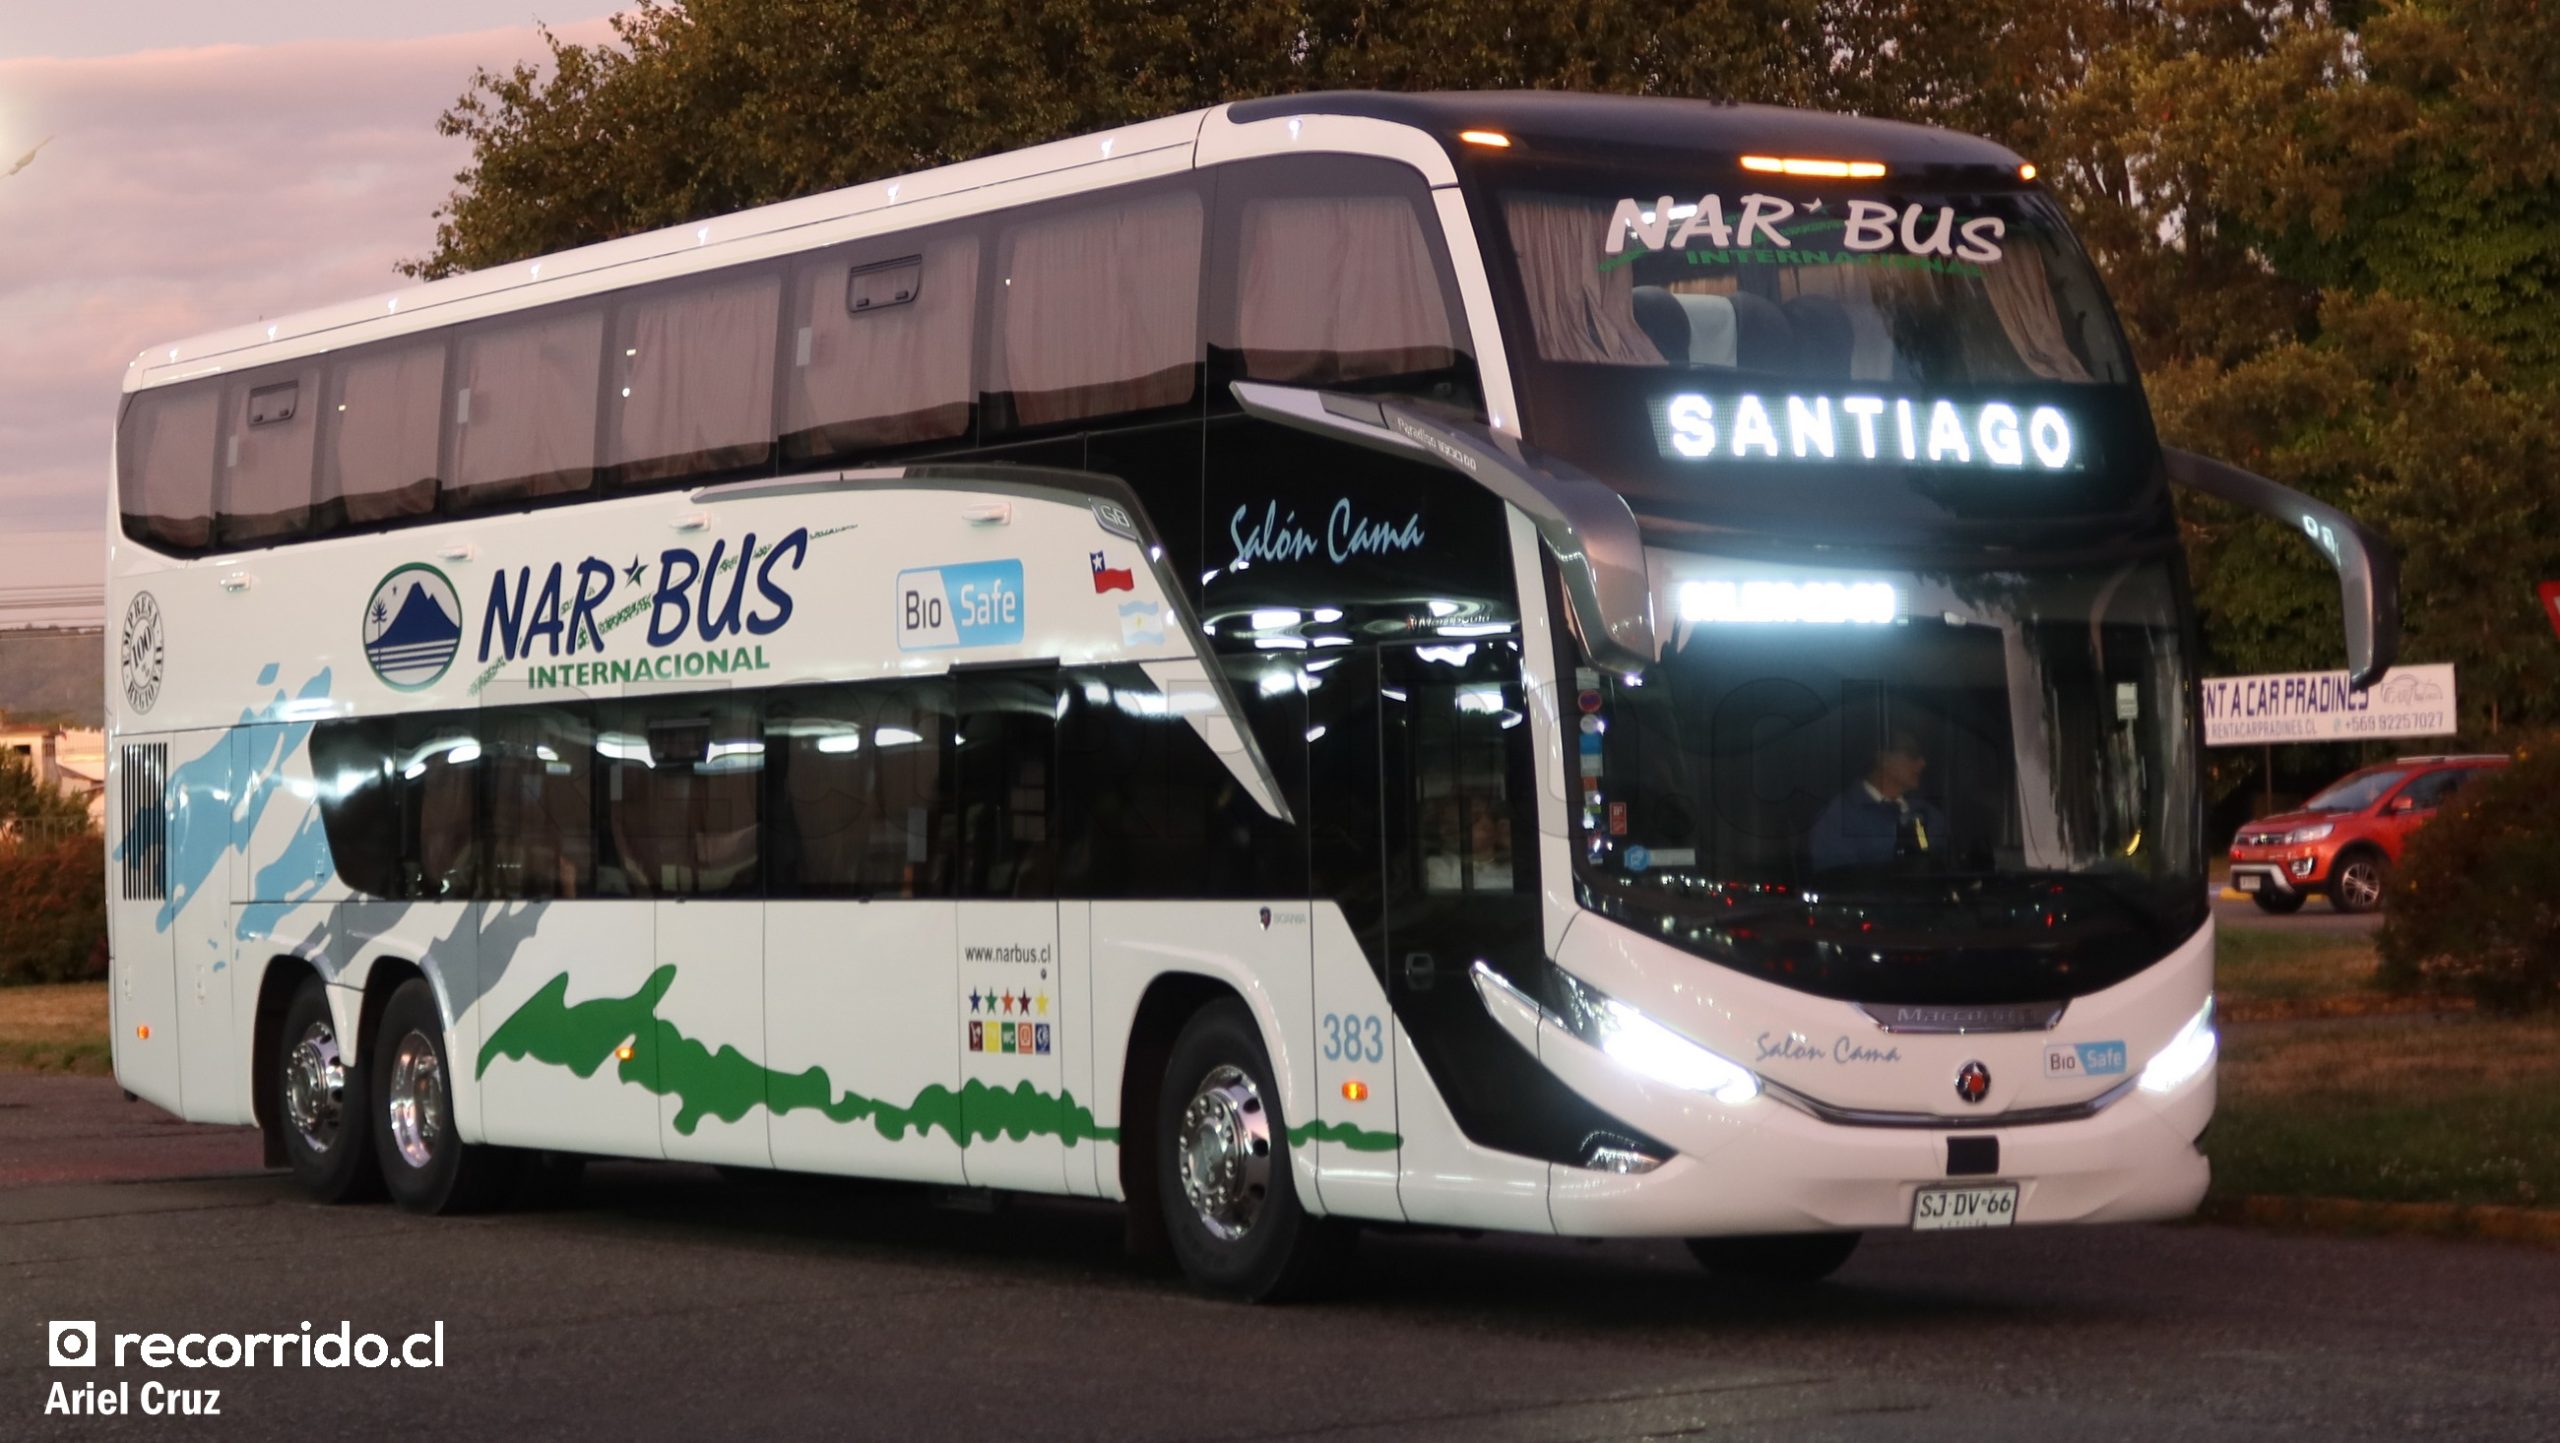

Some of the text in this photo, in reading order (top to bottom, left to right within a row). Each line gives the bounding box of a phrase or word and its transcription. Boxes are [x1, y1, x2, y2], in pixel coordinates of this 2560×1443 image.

[1605, 193, 2006, 264] NAR BUS
[1668, 394, 2073, 468] SANTIAGO
[1230, 497, 1425, 571] Salón Cama
[478, 525, 808, 665] NAR BUS
[959, 587, 1017, 628] Safe
[528, 645, 771, 691] INTERNACIONAL
[2230, 681, 2242, 719] A
[2246, 679, 2280, 717] CAR
[964, 942, 1051, 964] www.narbus.cl
[1323, 1013, 1384, 1064] 383
[1833, 1035, 1901, 1065] Cama
[2086, 1048, 2122, 1068] Safe
